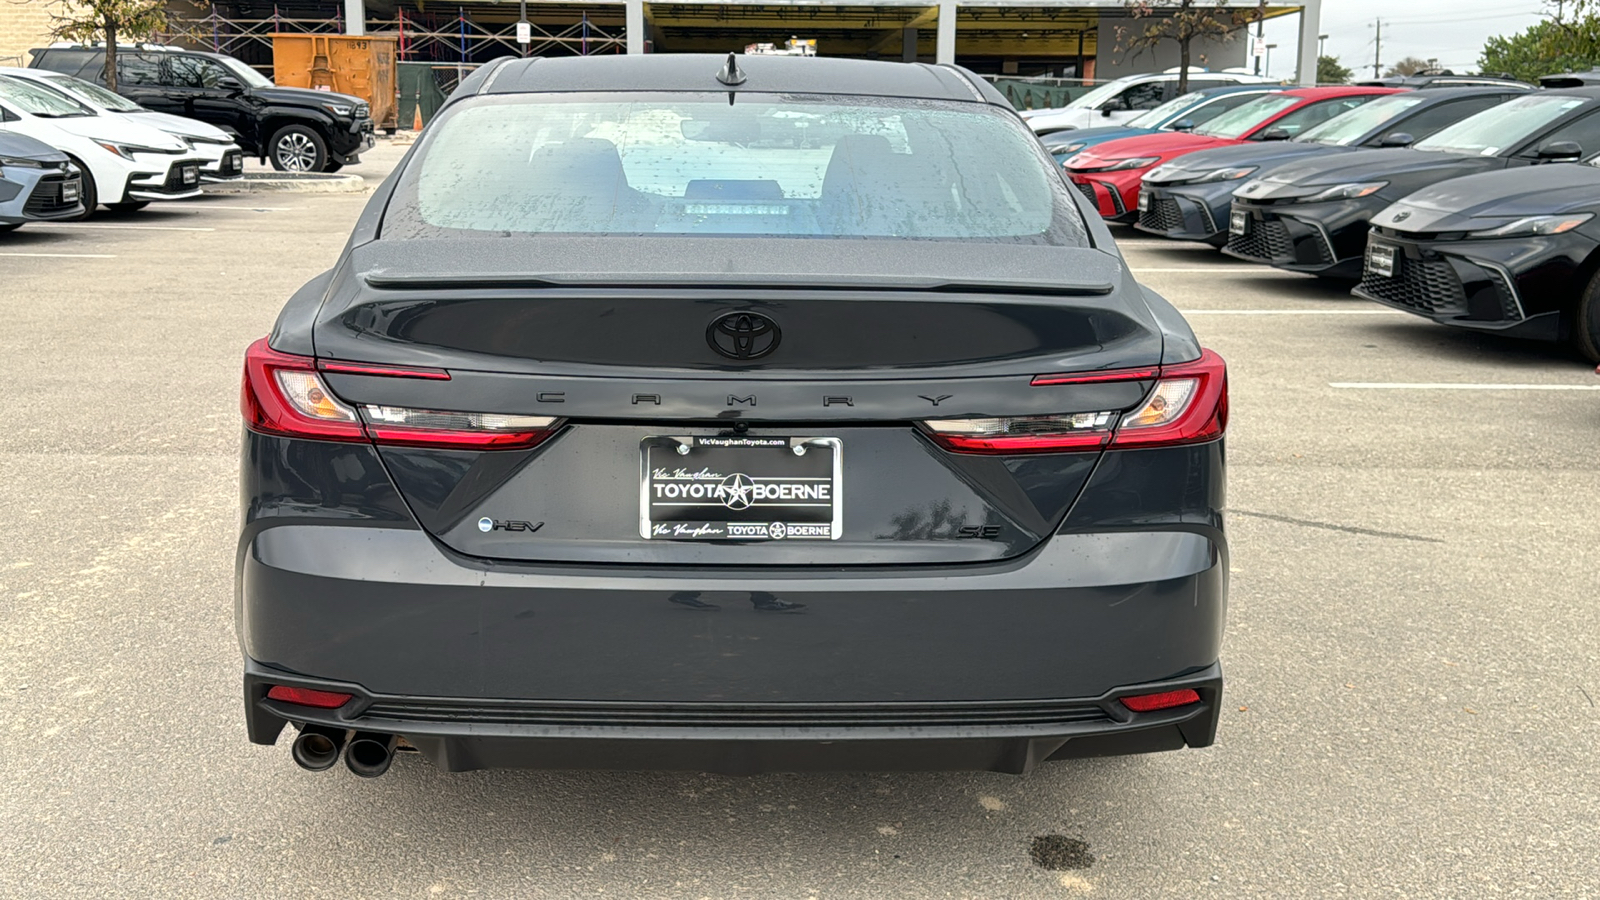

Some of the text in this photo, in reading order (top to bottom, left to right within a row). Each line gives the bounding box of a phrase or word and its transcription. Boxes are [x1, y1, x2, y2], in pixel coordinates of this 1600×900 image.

[536, 391, 953, 407] CAMRY
[699, 438, 785, 447] VicVaughanToyota.com
[652, 467, 723, 482] Vic Vaughan
[653, 483, 727, 498] TOYOTA
[752, 484, 831, 499] BOERNE
[493, 519, 545, 533] HEV
[652, 523, 671, 536] Vic
[673, 523, 724, 538] Vaughan
[727, 525, 768, 535] TOYOTA
[786, 526, 831, 535] BOERNE
[956, 524, 1001, 538] SE
